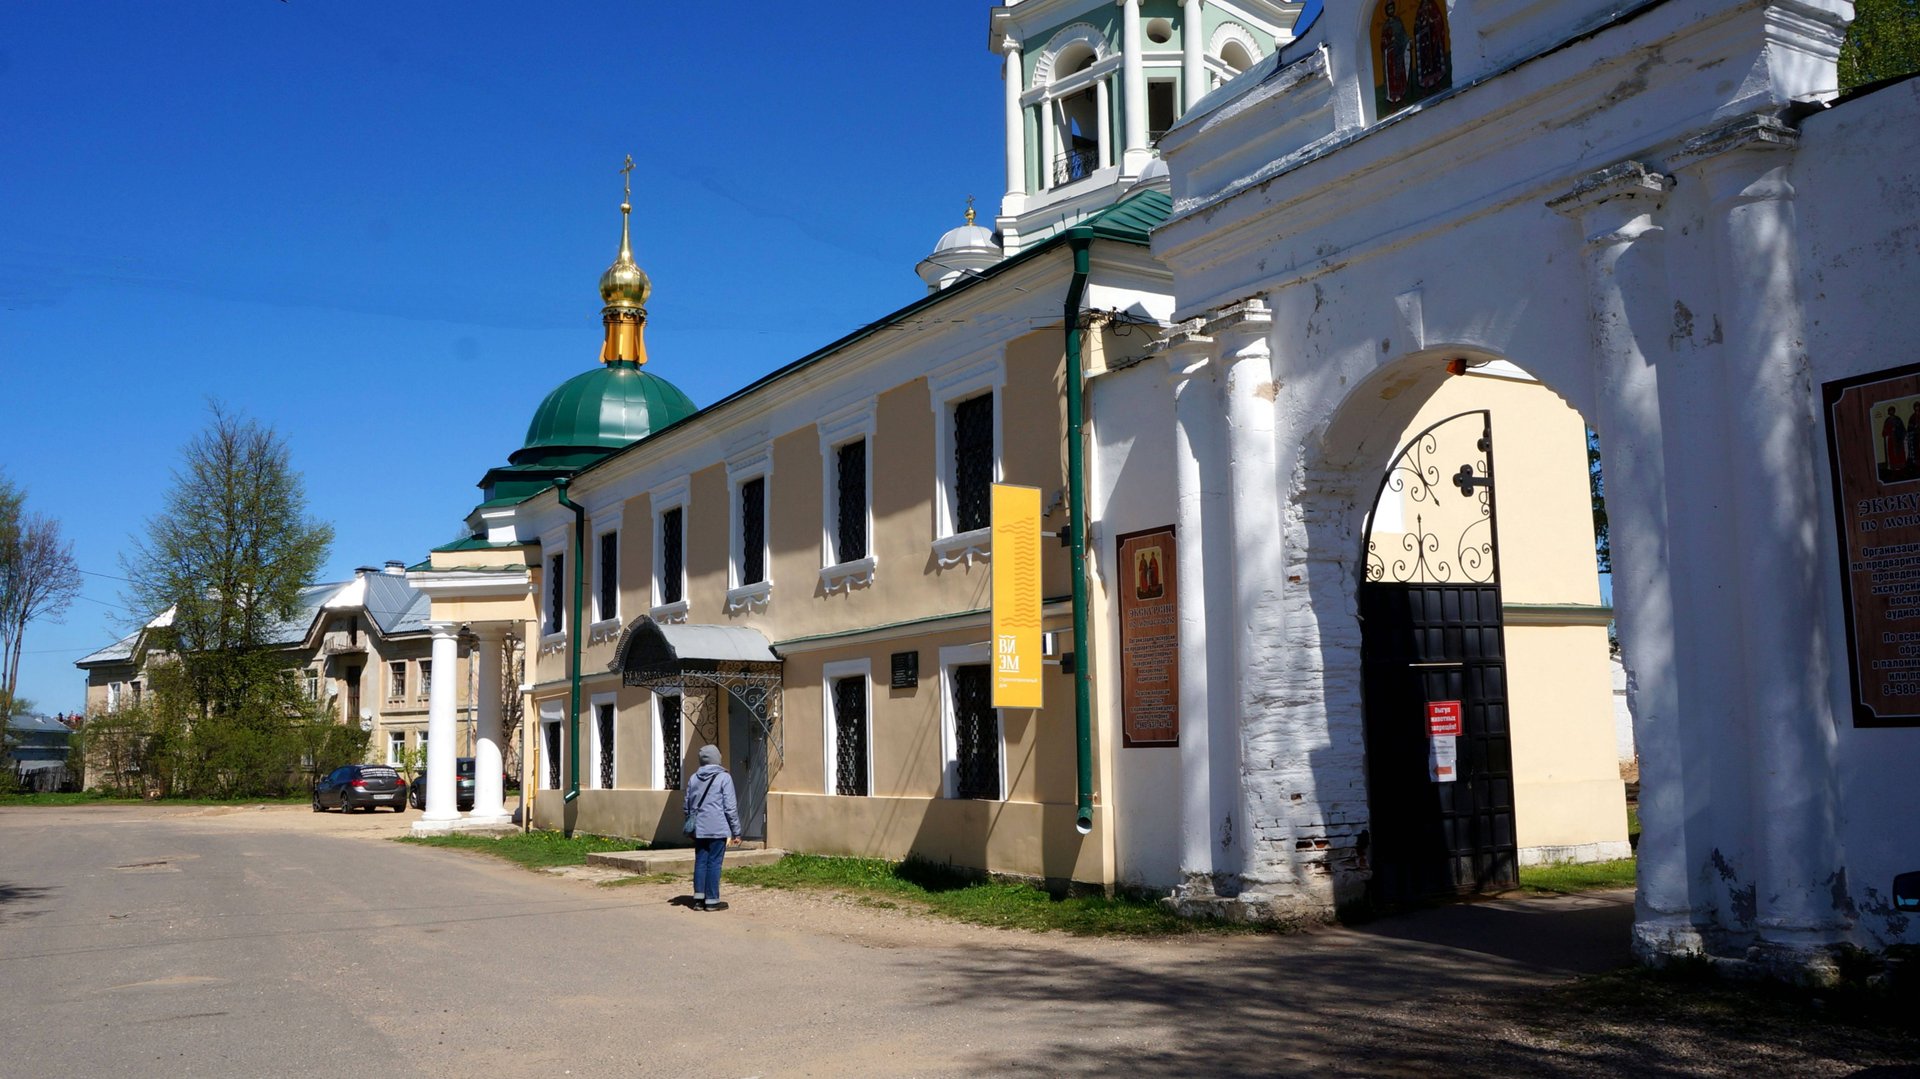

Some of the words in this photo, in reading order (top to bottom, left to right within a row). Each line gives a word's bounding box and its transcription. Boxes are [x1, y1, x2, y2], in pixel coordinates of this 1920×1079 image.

[1861, 520, 1877, 531] по
[1862, 543, 1920, 558] Организаци
[1852, 562, 1863, 571] по
[1889, 596, 1920, 607] воскр
[1883, 632, 1896, 643] По
[999, 638, 1016, 654] ВИ
[999, 654, 1019, 669] ЭМ
[1889, 672, 1907, 681] или
